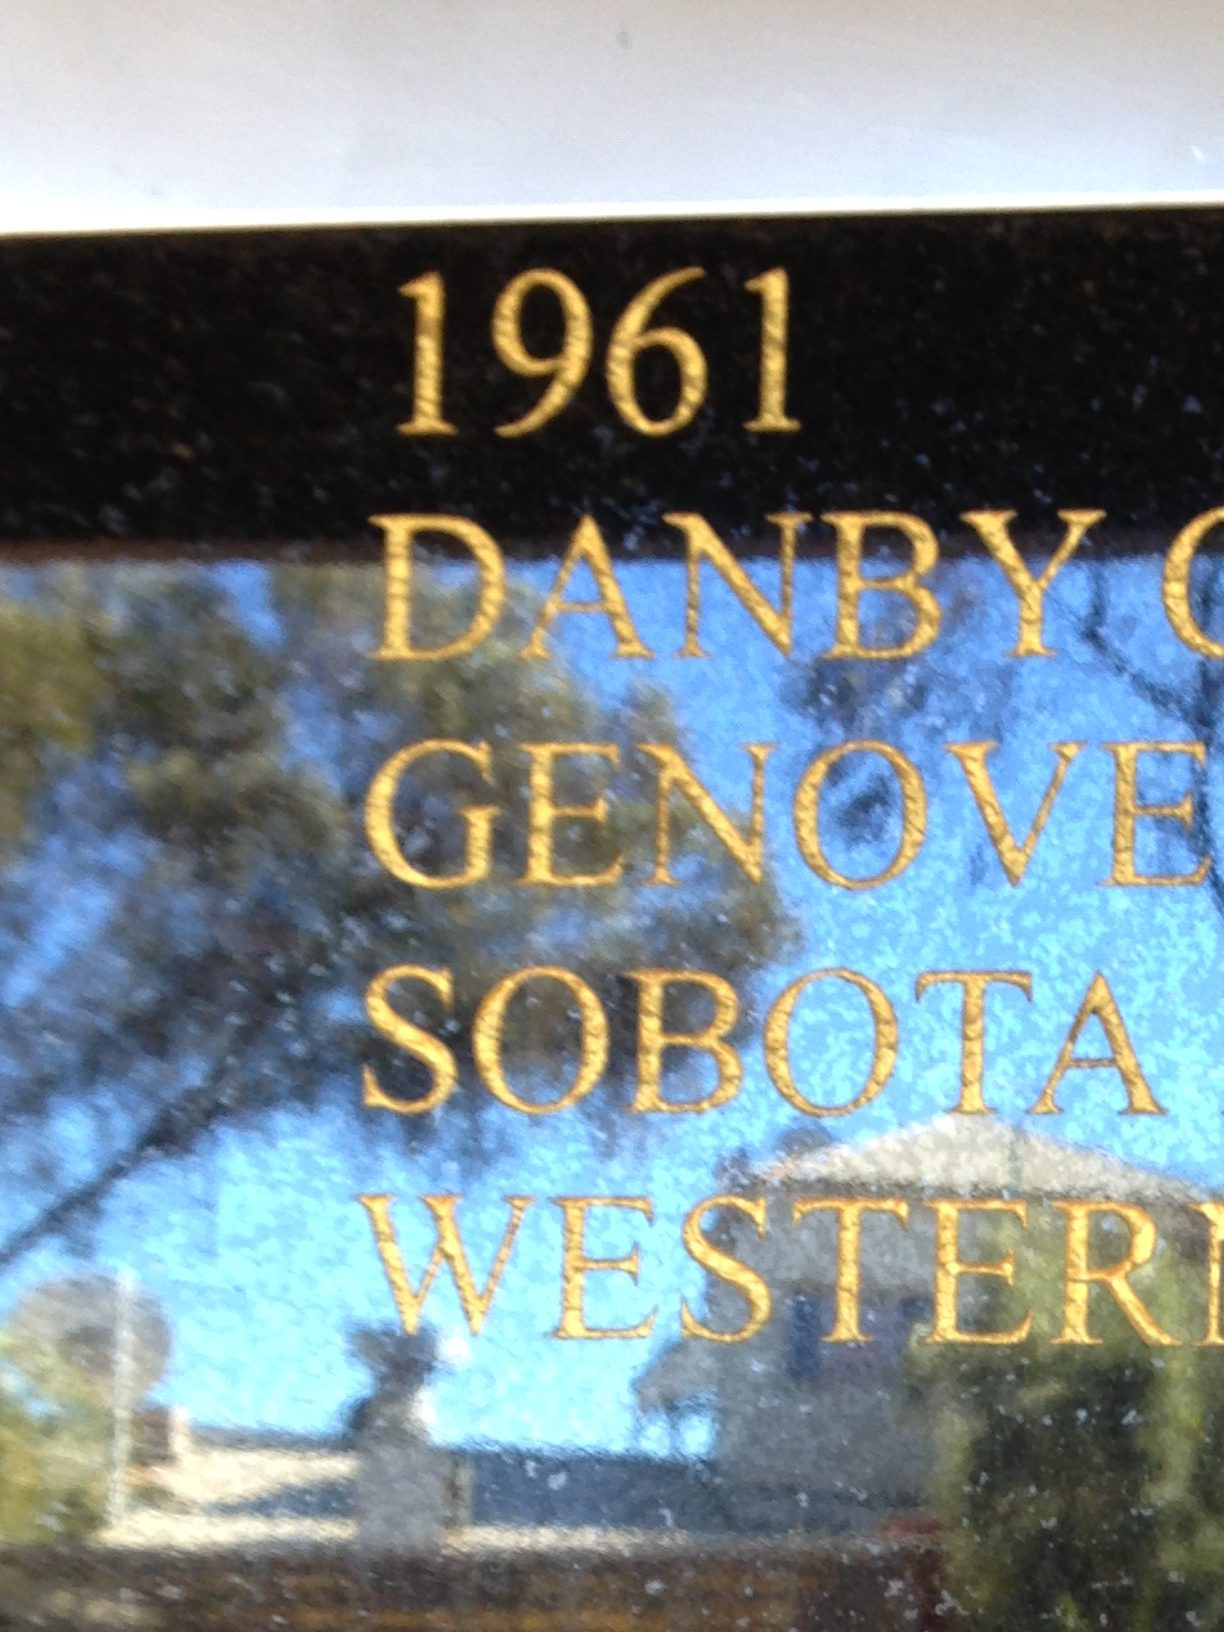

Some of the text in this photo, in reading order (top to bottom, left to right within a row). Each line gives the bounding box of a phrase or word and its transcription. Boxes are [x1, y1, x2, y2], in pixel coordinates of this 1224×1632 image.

[397, 266, 800, 436] 1961
[366, 508, 1107, 662] DANBY
[361, 965, 1167, 1118] SOBOTA
